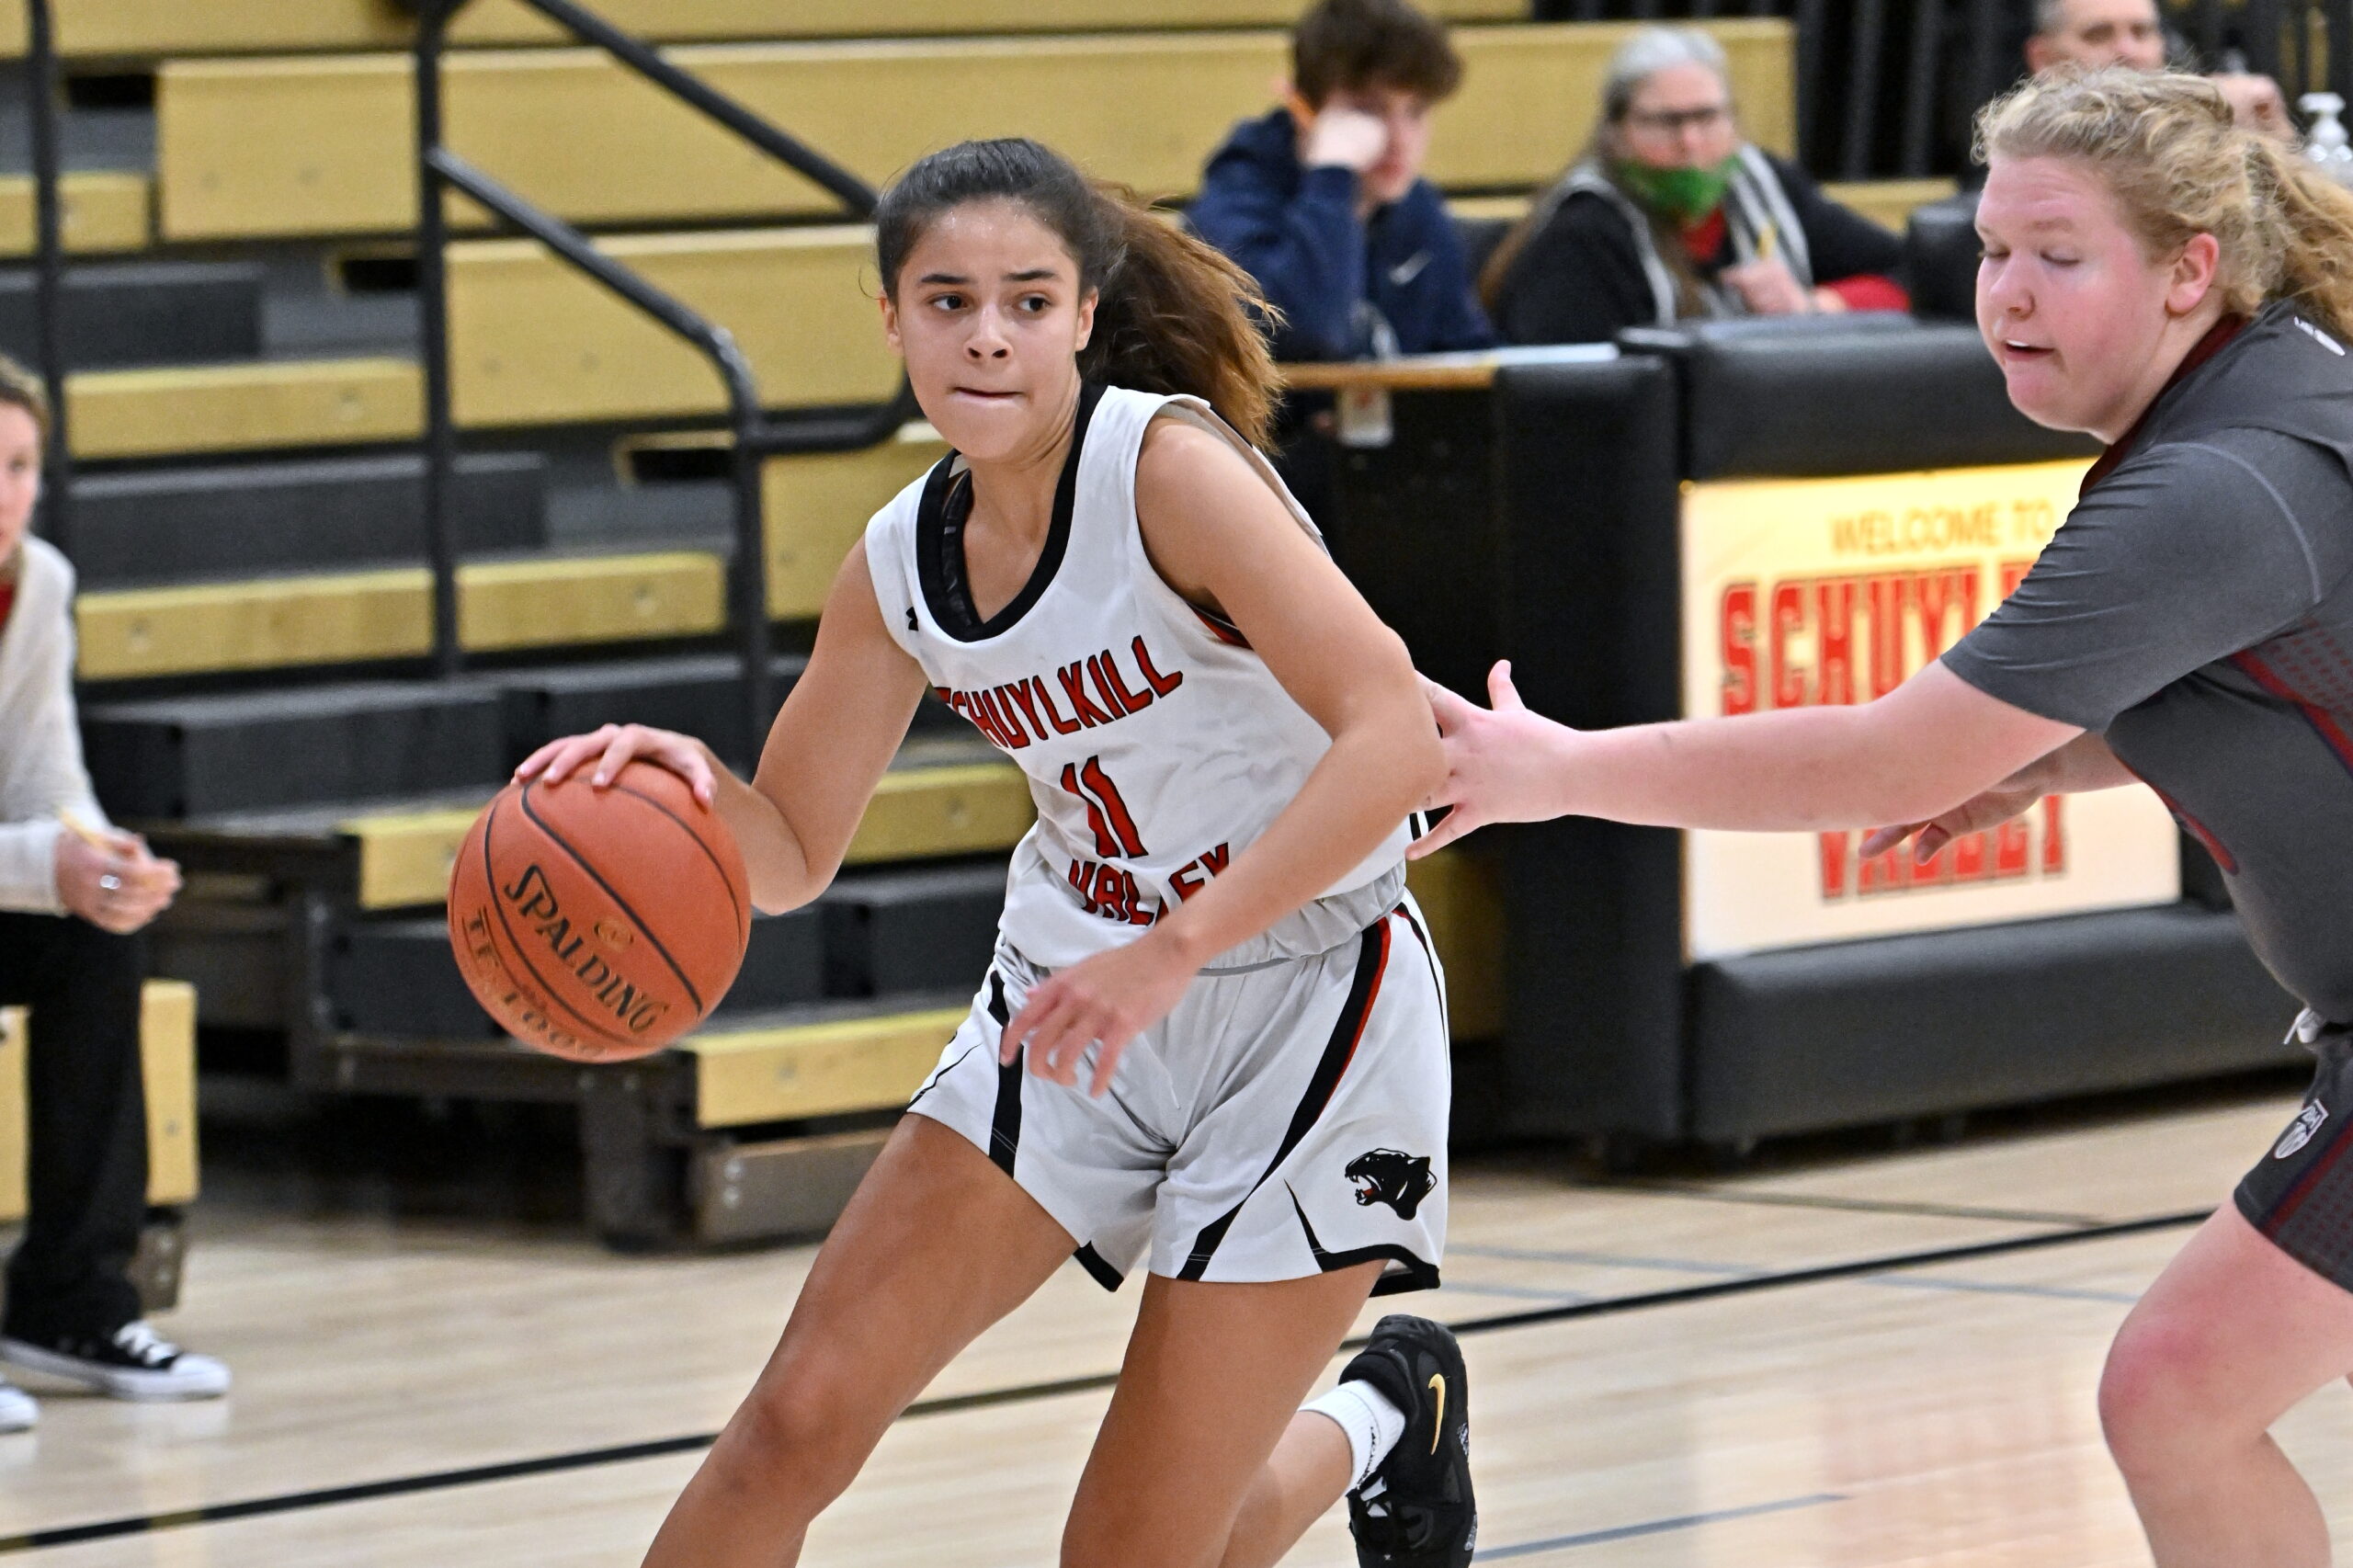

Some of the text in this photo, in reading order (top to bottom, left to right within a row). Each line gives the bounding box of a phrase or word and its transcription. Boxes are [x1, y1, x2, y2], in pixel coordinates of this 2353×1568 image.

[1831, 499, 2054, 555] WELCOME TO
[1060, 755, 1148, 859] 11
[504, 865, 671, 1032] SPALDING
